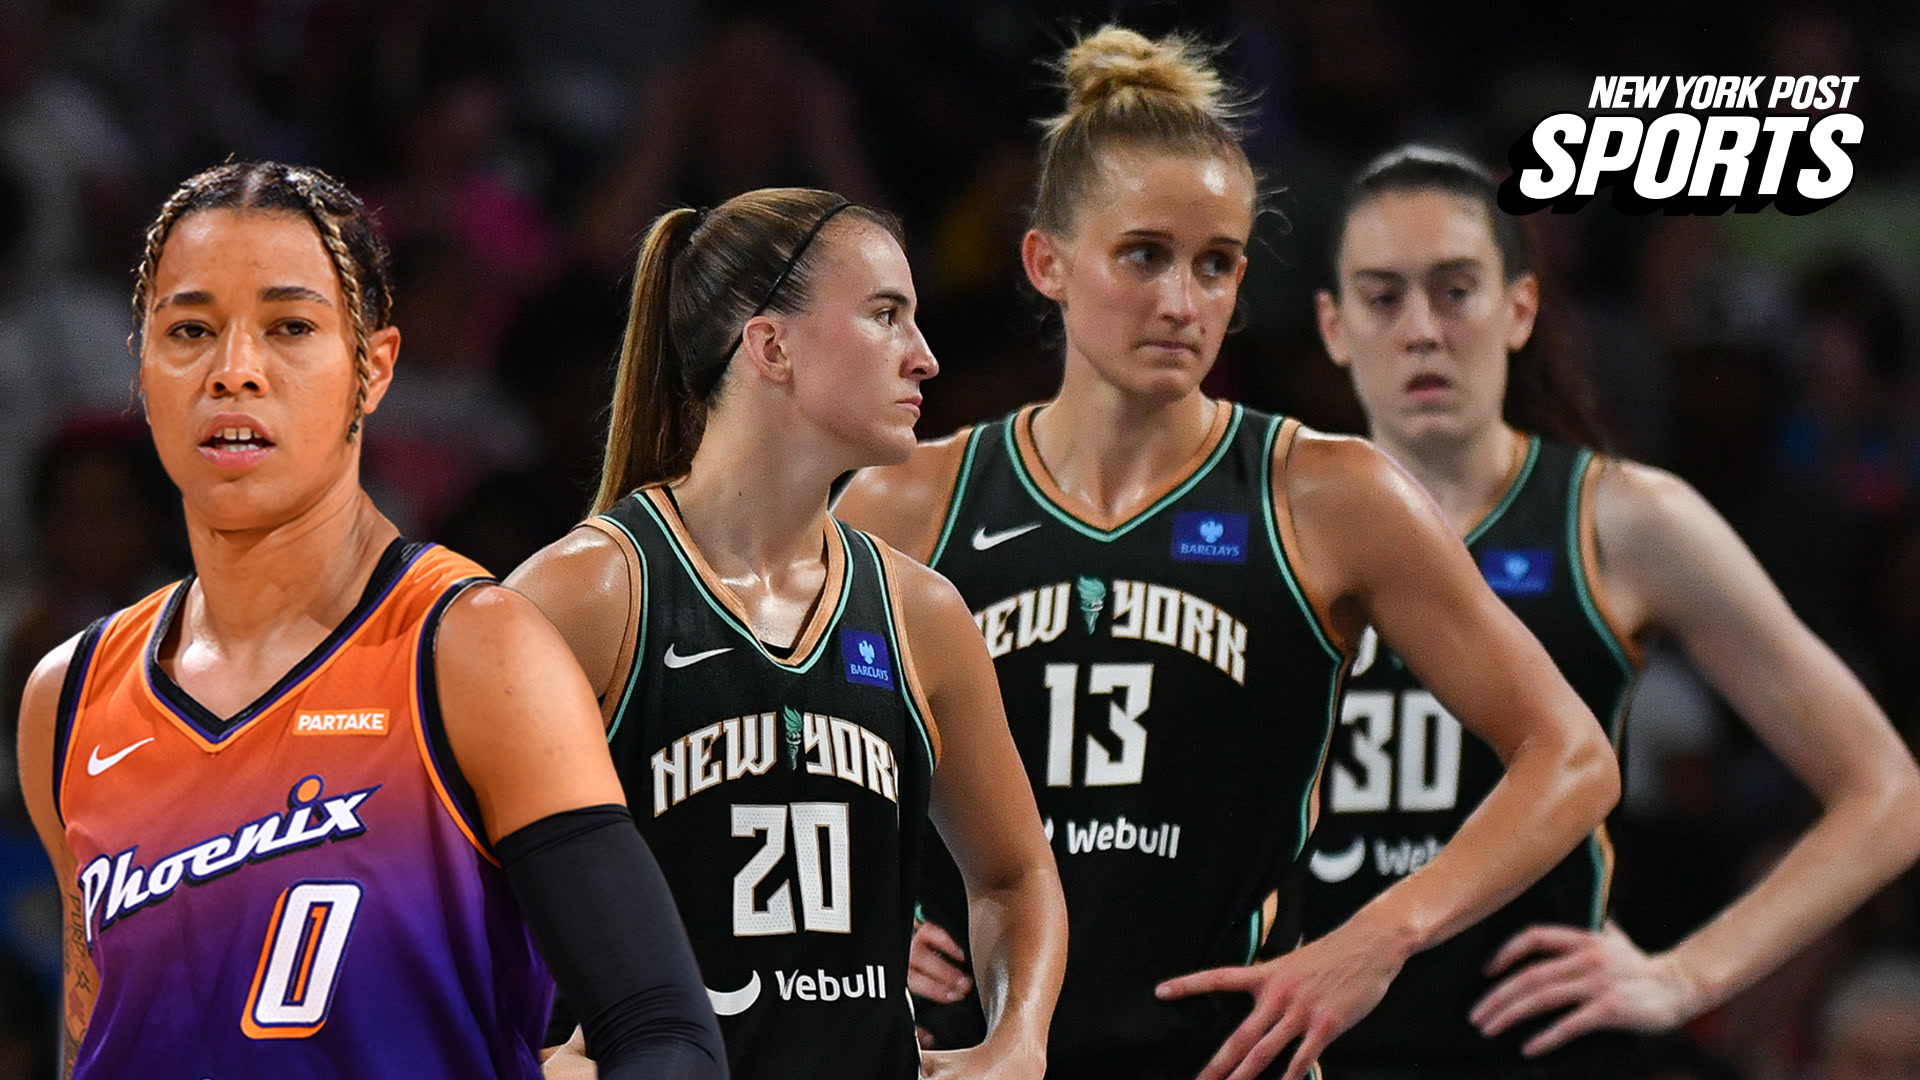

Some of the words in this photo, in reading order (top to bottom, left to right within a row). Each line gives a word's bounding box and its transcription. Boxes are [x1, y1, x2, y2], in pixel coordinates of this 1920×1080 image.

[1180, 543, 1240, 557] BARCLAYS
[850, 664, 889, 681] BARCLAYS
[1111, 579, 1248, 687] YORK
[297, 713, 385, 731] PARTAKE
[651, 711, 777, 818] NEW
[1044, 662, 1155, 788] 13
[1330, 689, 1463, 813] 30
[79, 775, 383, 948] Phoenix
[731, 802, 852, 937] 20
[1066, 817, 1181, 859] Webull
[242, 880, 363, 1039] 0
